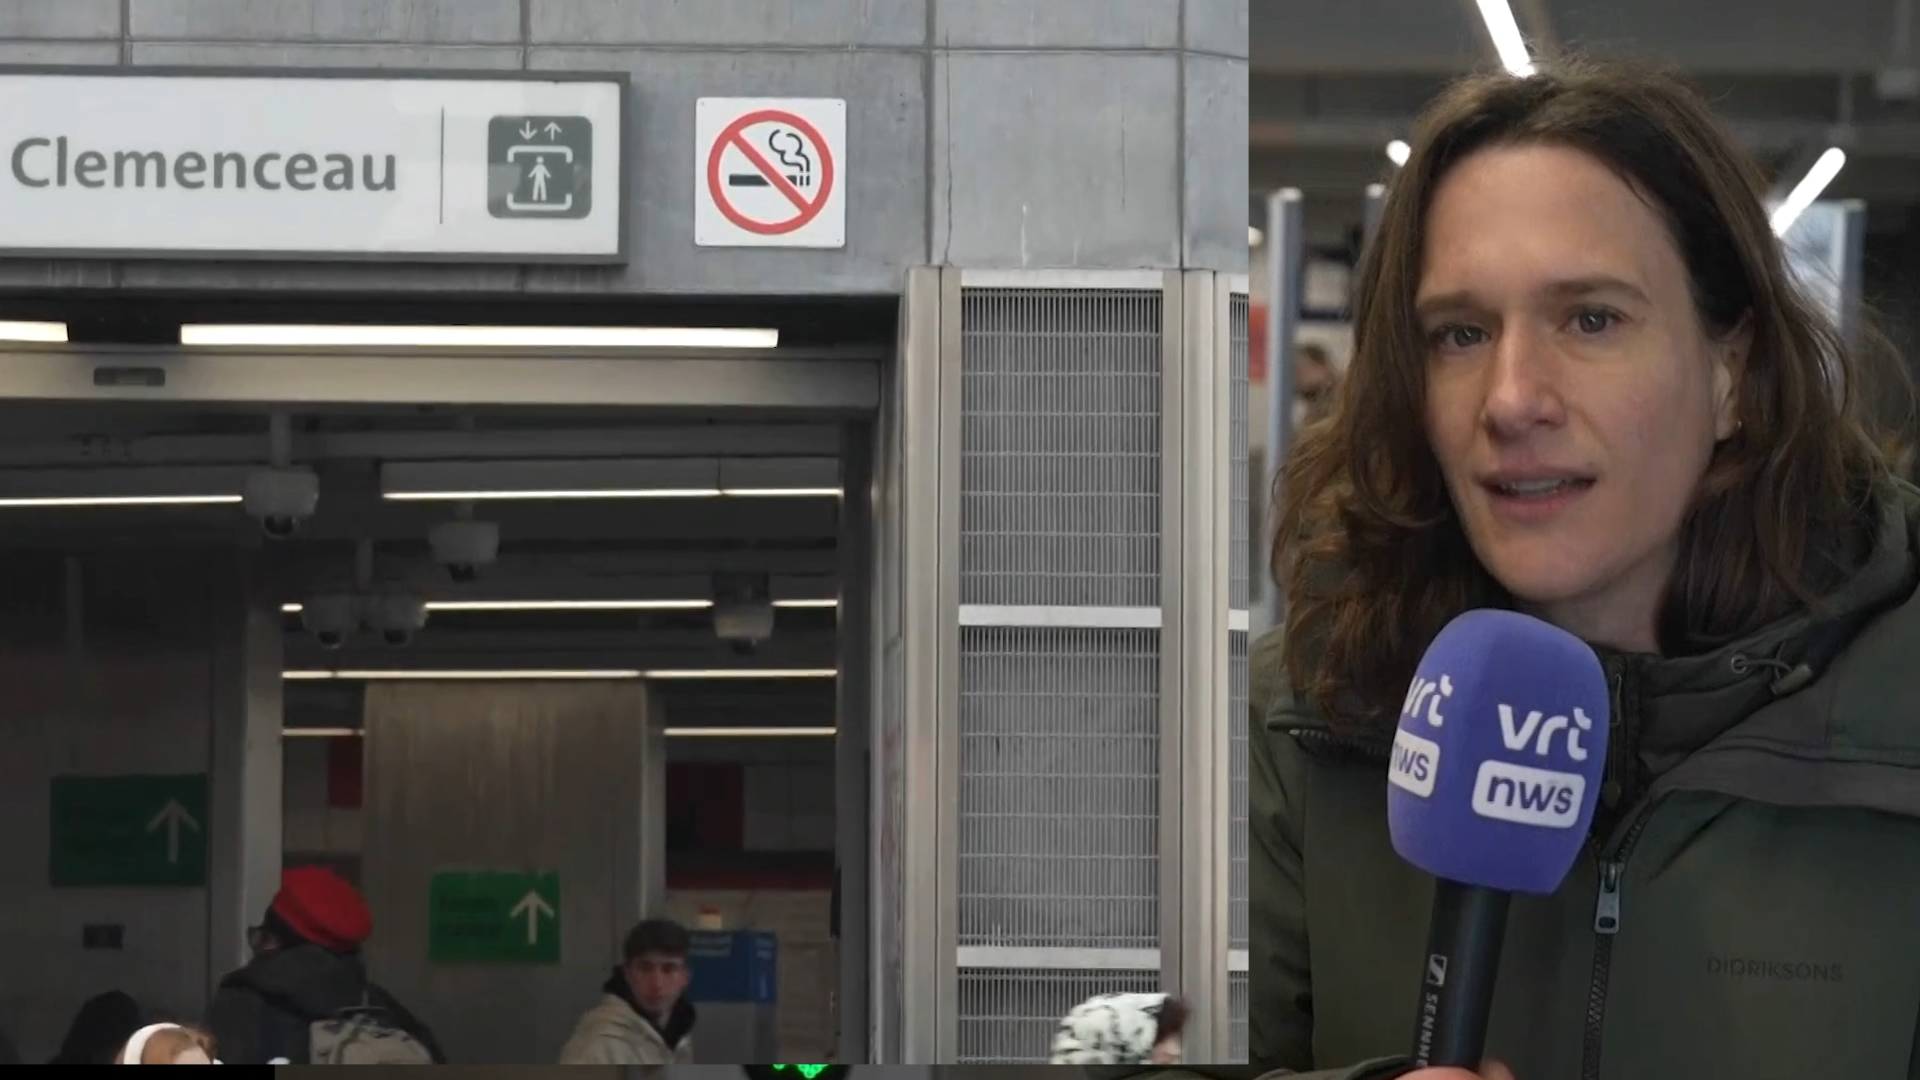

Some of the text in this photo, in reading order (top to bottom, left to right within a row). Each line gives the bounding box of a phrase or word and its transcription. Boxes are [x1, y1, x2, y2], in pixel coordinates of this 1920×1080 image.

[11, 136, 397, 191] Clemenceau
[1403, 673, 1453, 727] vrt
[1498, 704, 1592, 761] vrt
[1486, 775, 1574, 815] nws
[1707, 955, 1843, 982] DIDRIKSONS
